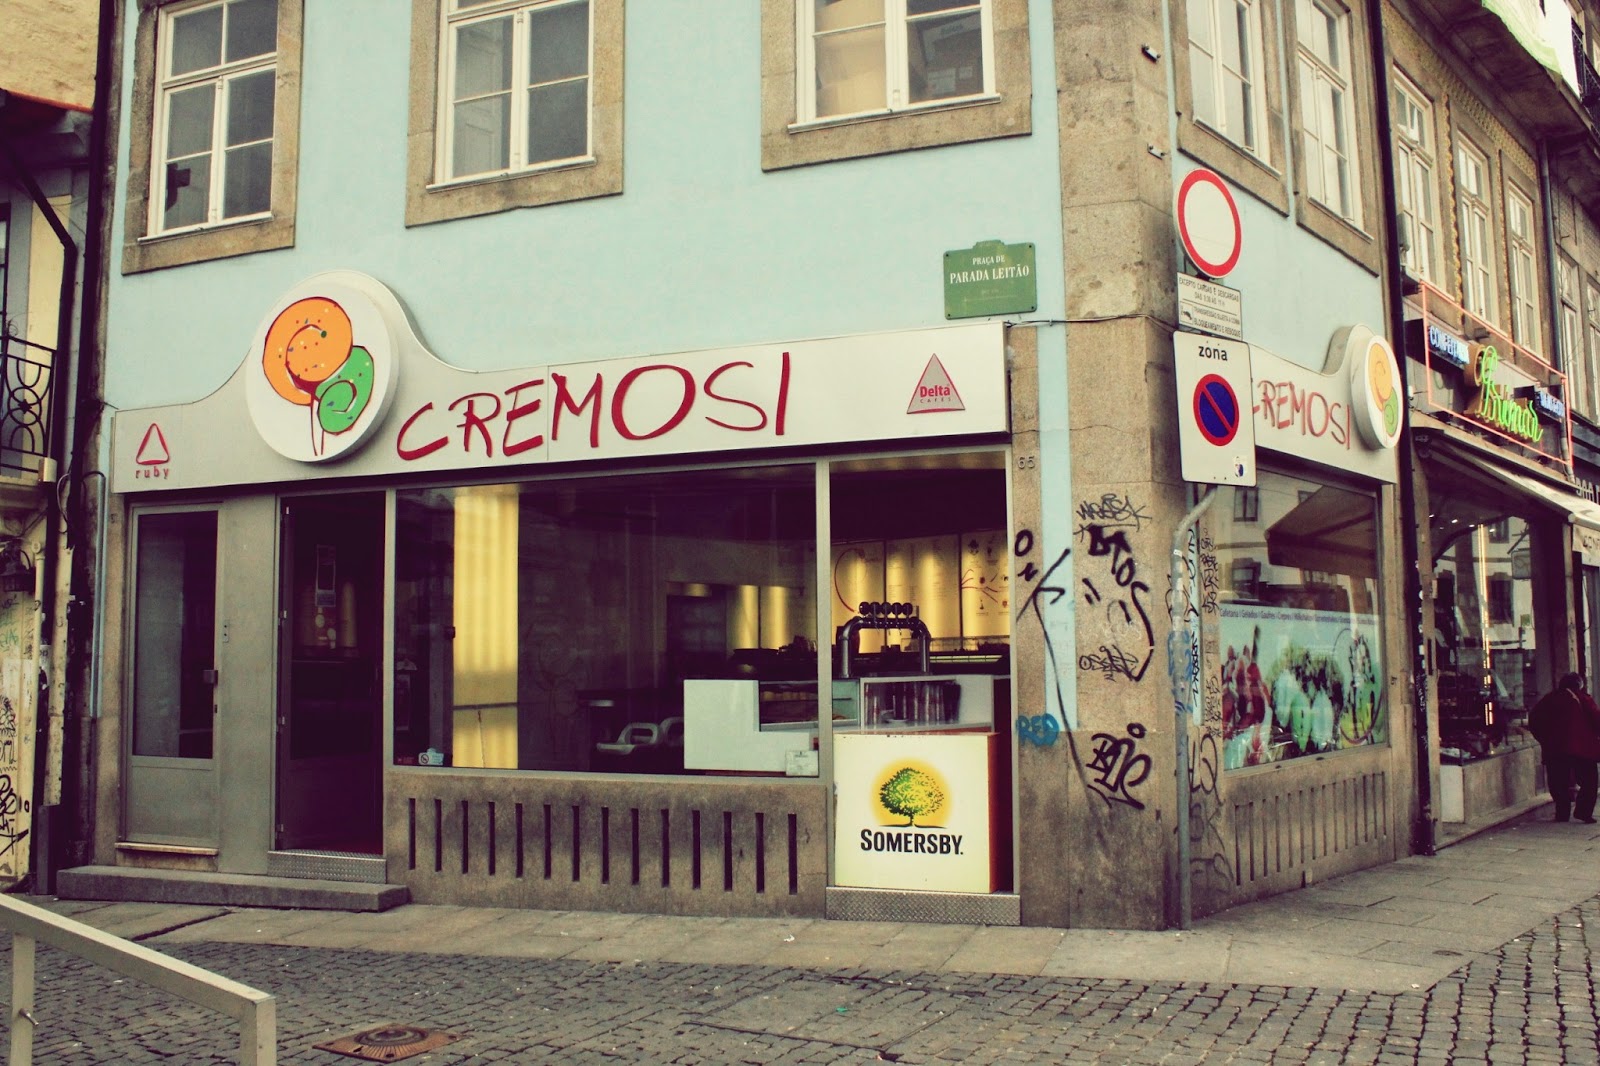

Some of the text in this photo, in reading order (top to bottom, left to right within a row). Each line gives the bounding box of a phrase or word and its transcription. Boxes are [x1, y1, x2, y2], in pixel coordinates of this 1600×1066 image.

[972, 255, 1005, 266] PRAÇA DE
[950, 263, 1030, 284] PARADA LEITÃO
[1196, 283, 1212, 294] CARGAS
[1217, 289, 1239, 302] DESCARGAS
[1198, 345, 1228, 361] zona
[920, 385, 950, 398] Delta
[396, 352, 790, 461] CREMOSI
[1252, 379, 1350, 451] REMOSI
[1018, 455, 1036, 470] 65
[135, 465, 169, 480] ruby
